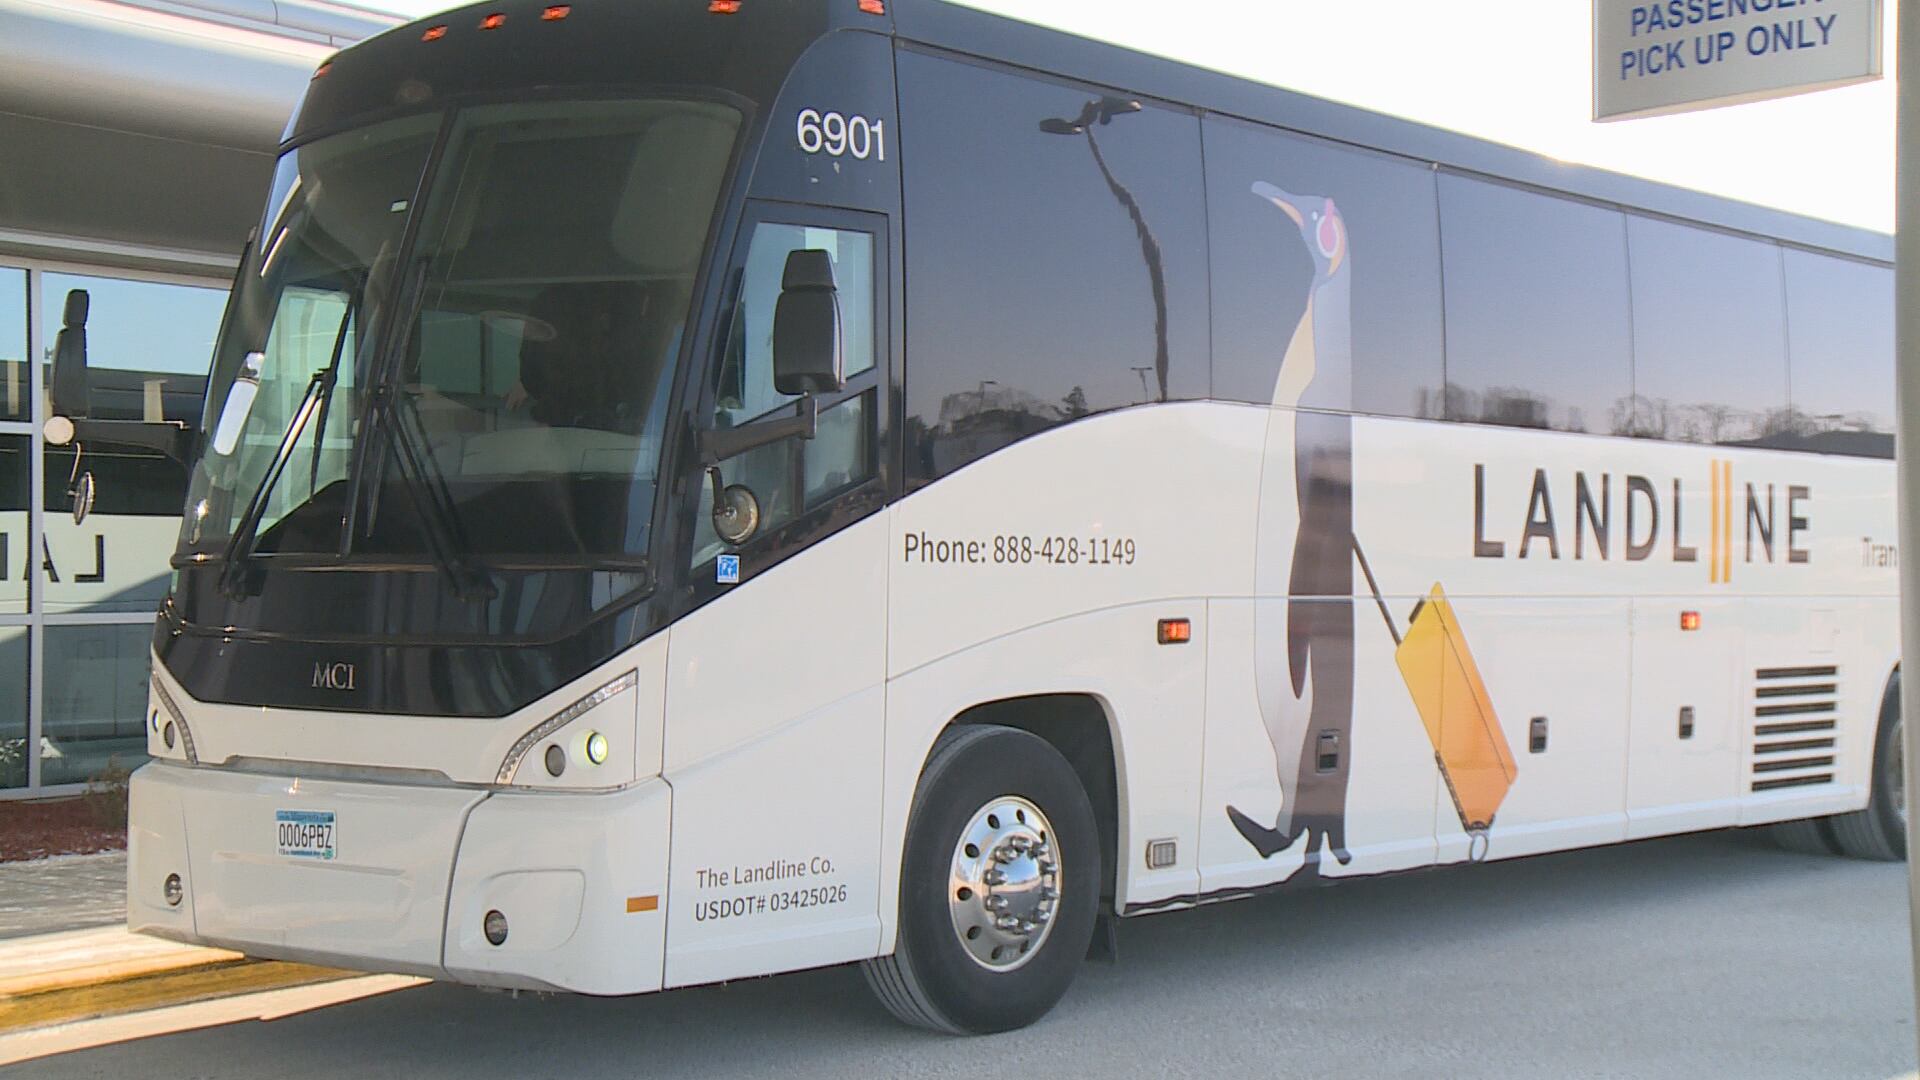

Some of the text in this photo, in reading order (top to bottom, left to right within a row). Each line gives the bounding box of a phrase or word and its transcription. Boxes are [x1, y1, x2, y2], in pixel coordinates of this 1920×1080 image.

[1630, 0, 1824, 37] PASSEN
[1620, 14, 1838, 81] PICK UP ONLY
[797, 108, 884, 161] 6901
[904, 531, 1136, 565] Phone: 888-428-1149
[311, 661, 355, 690] MCI
[279, 823, 333, 849] 0006PBZ
[696, 856, 836, 889] The Landline Co.
[695, 884, 847, 922] USDOT# 03425026
